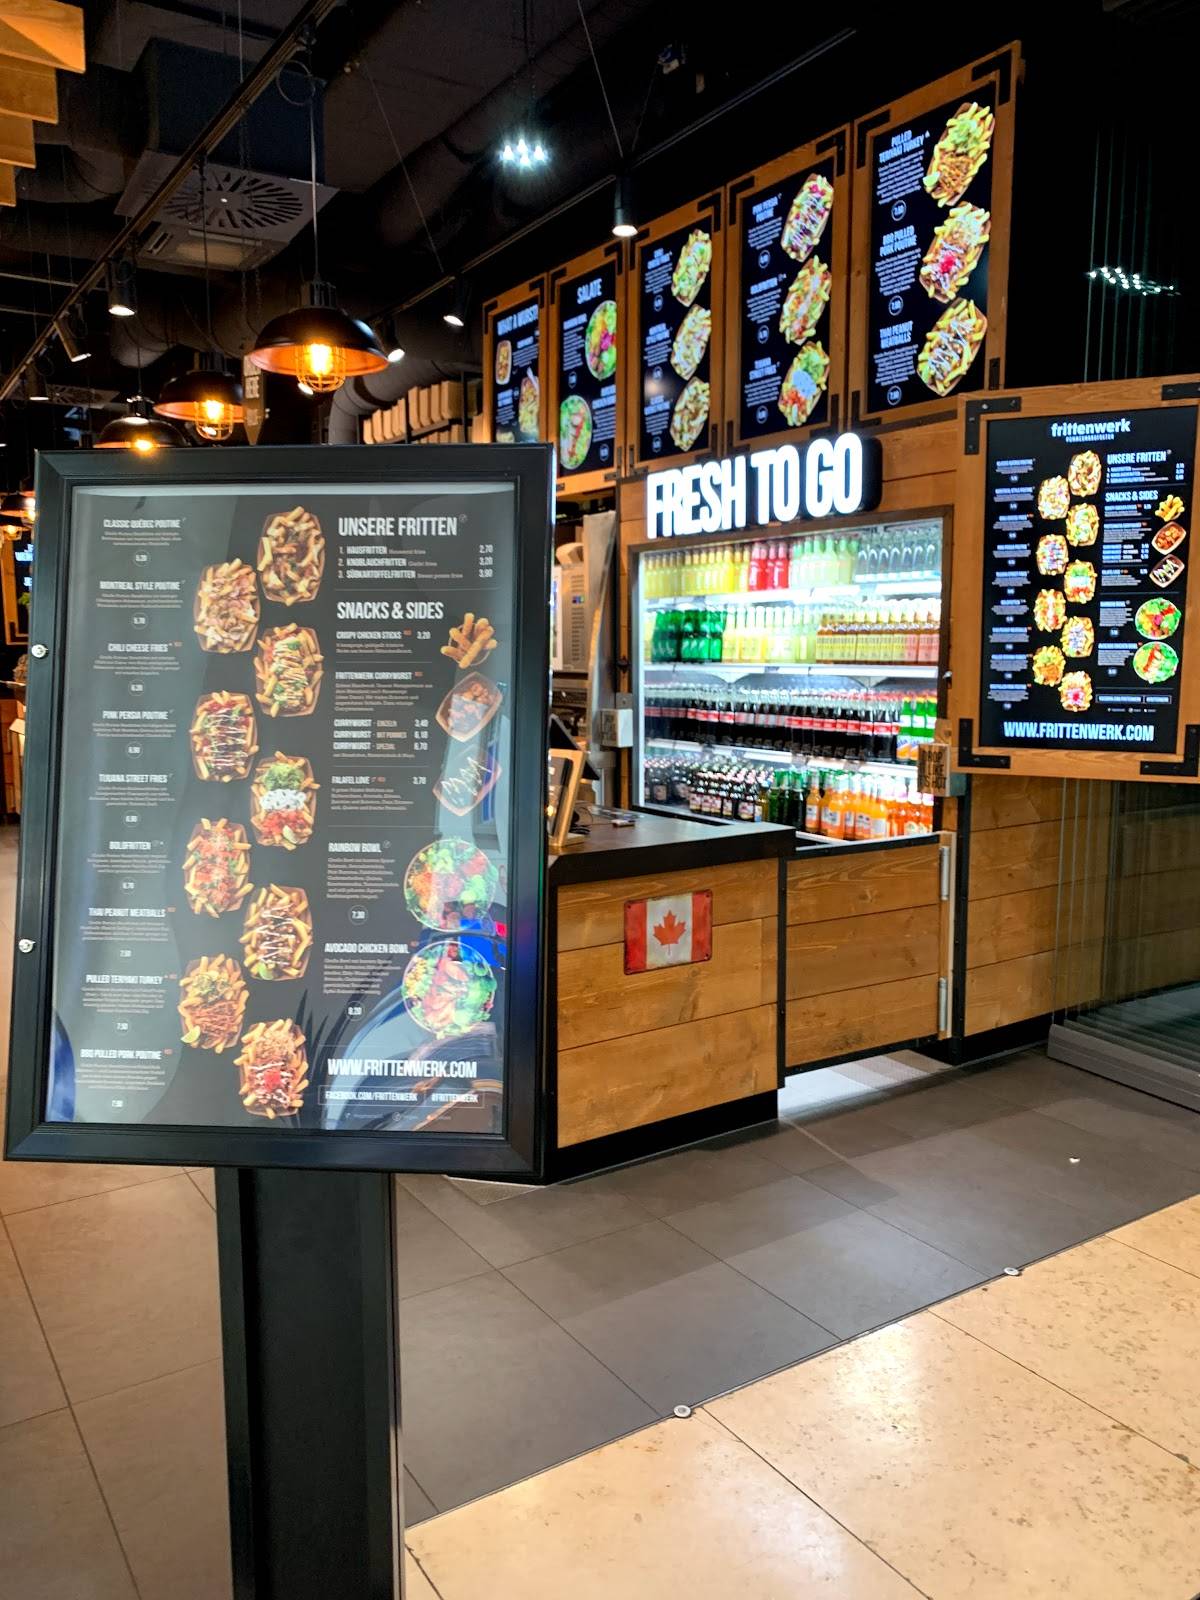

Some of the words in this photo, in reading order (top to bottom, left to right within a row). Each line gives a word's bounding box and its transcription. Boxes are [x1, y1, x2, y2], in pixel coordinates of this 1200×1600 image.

[577, 278, 602, 304] SALATE
[1051, 418, 1131, 437] frittenwerk
[1107, 453, 1135, 465] UNSERE
[1136, 451, 1167, 463] FRITTEN
[647, 455, 747, 539] FRESH
[751, 444, 800, 525] TO
[805, 432, 863, 518] GO
[1105, 491, 1132, 503] SNACKS
[1139, 489, 1159, 501] SIDES
[338, 517, 395, 537] UNSERE
[398, 516, 458, 537] FRITTEN
[336, 601, 390, 620] SNACKS
[391, 602, 404, 620] &
[405, 601, 445, 620] SIDES
[1003, 721, 1155, 742] WWW.FRITTENWERK.COM
[324, 942, 357, 953] AVOCADO
[357, 943, 388, 953] CHICKEN
[388, 943, 410, 954] BOWL
[86, 974, 110, 984] PULLED
[327, 1058, 477, 1078] WWW.FRITTENWERK.COM
